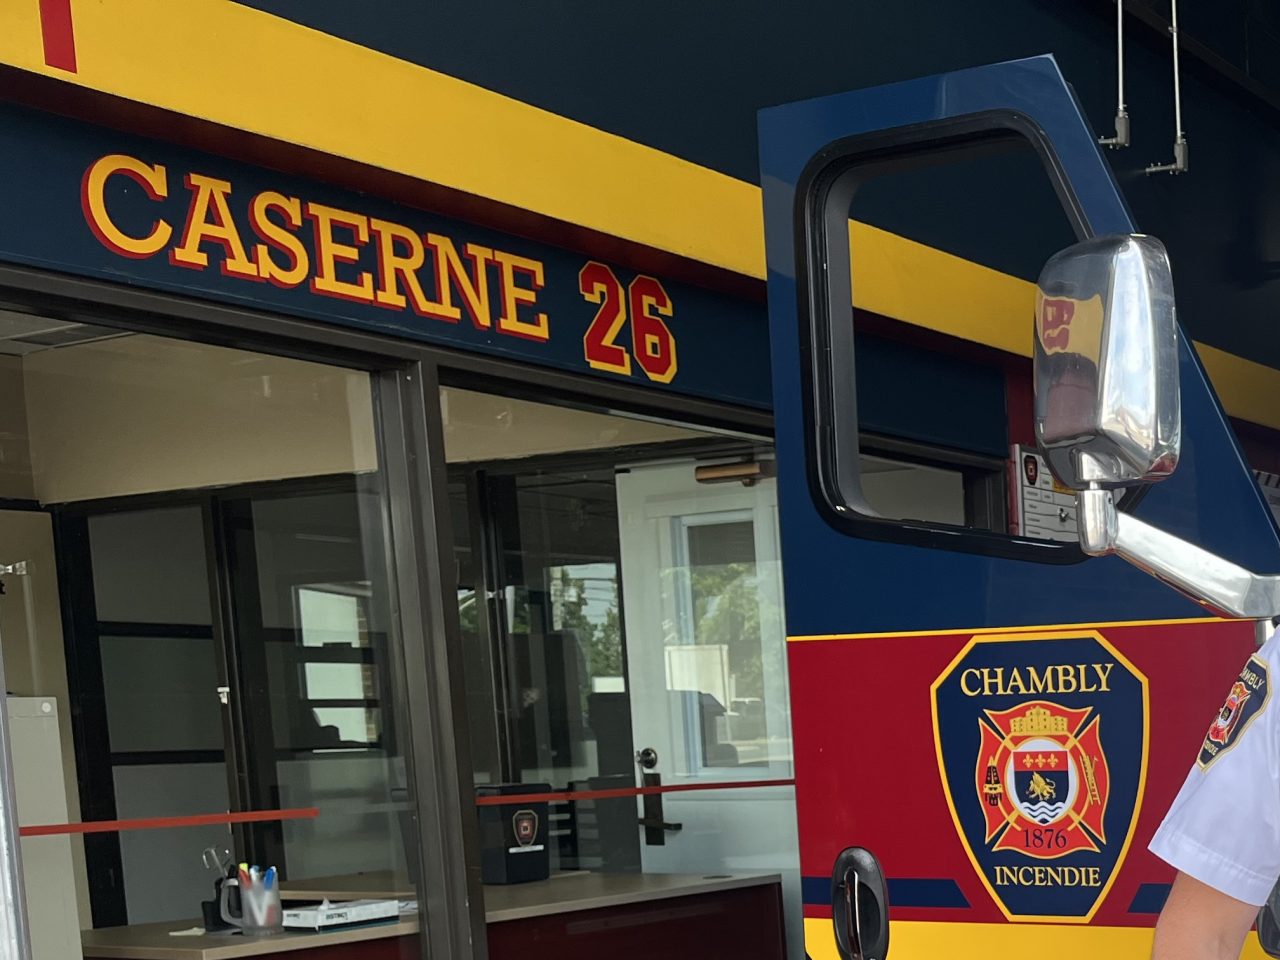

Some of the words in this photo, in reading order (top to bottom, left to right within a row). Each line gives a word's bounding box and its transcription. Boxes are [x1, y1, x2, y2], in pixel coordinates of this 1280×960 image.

[80, 153, 550, 343] CASERNE
[578, 260, 678, 385] 26
[960, 663, 1114, 697] CHAMBLY
[1023, 828, 1067, 849] 1876
[994, 866, 1101, 887] INCENDIE
